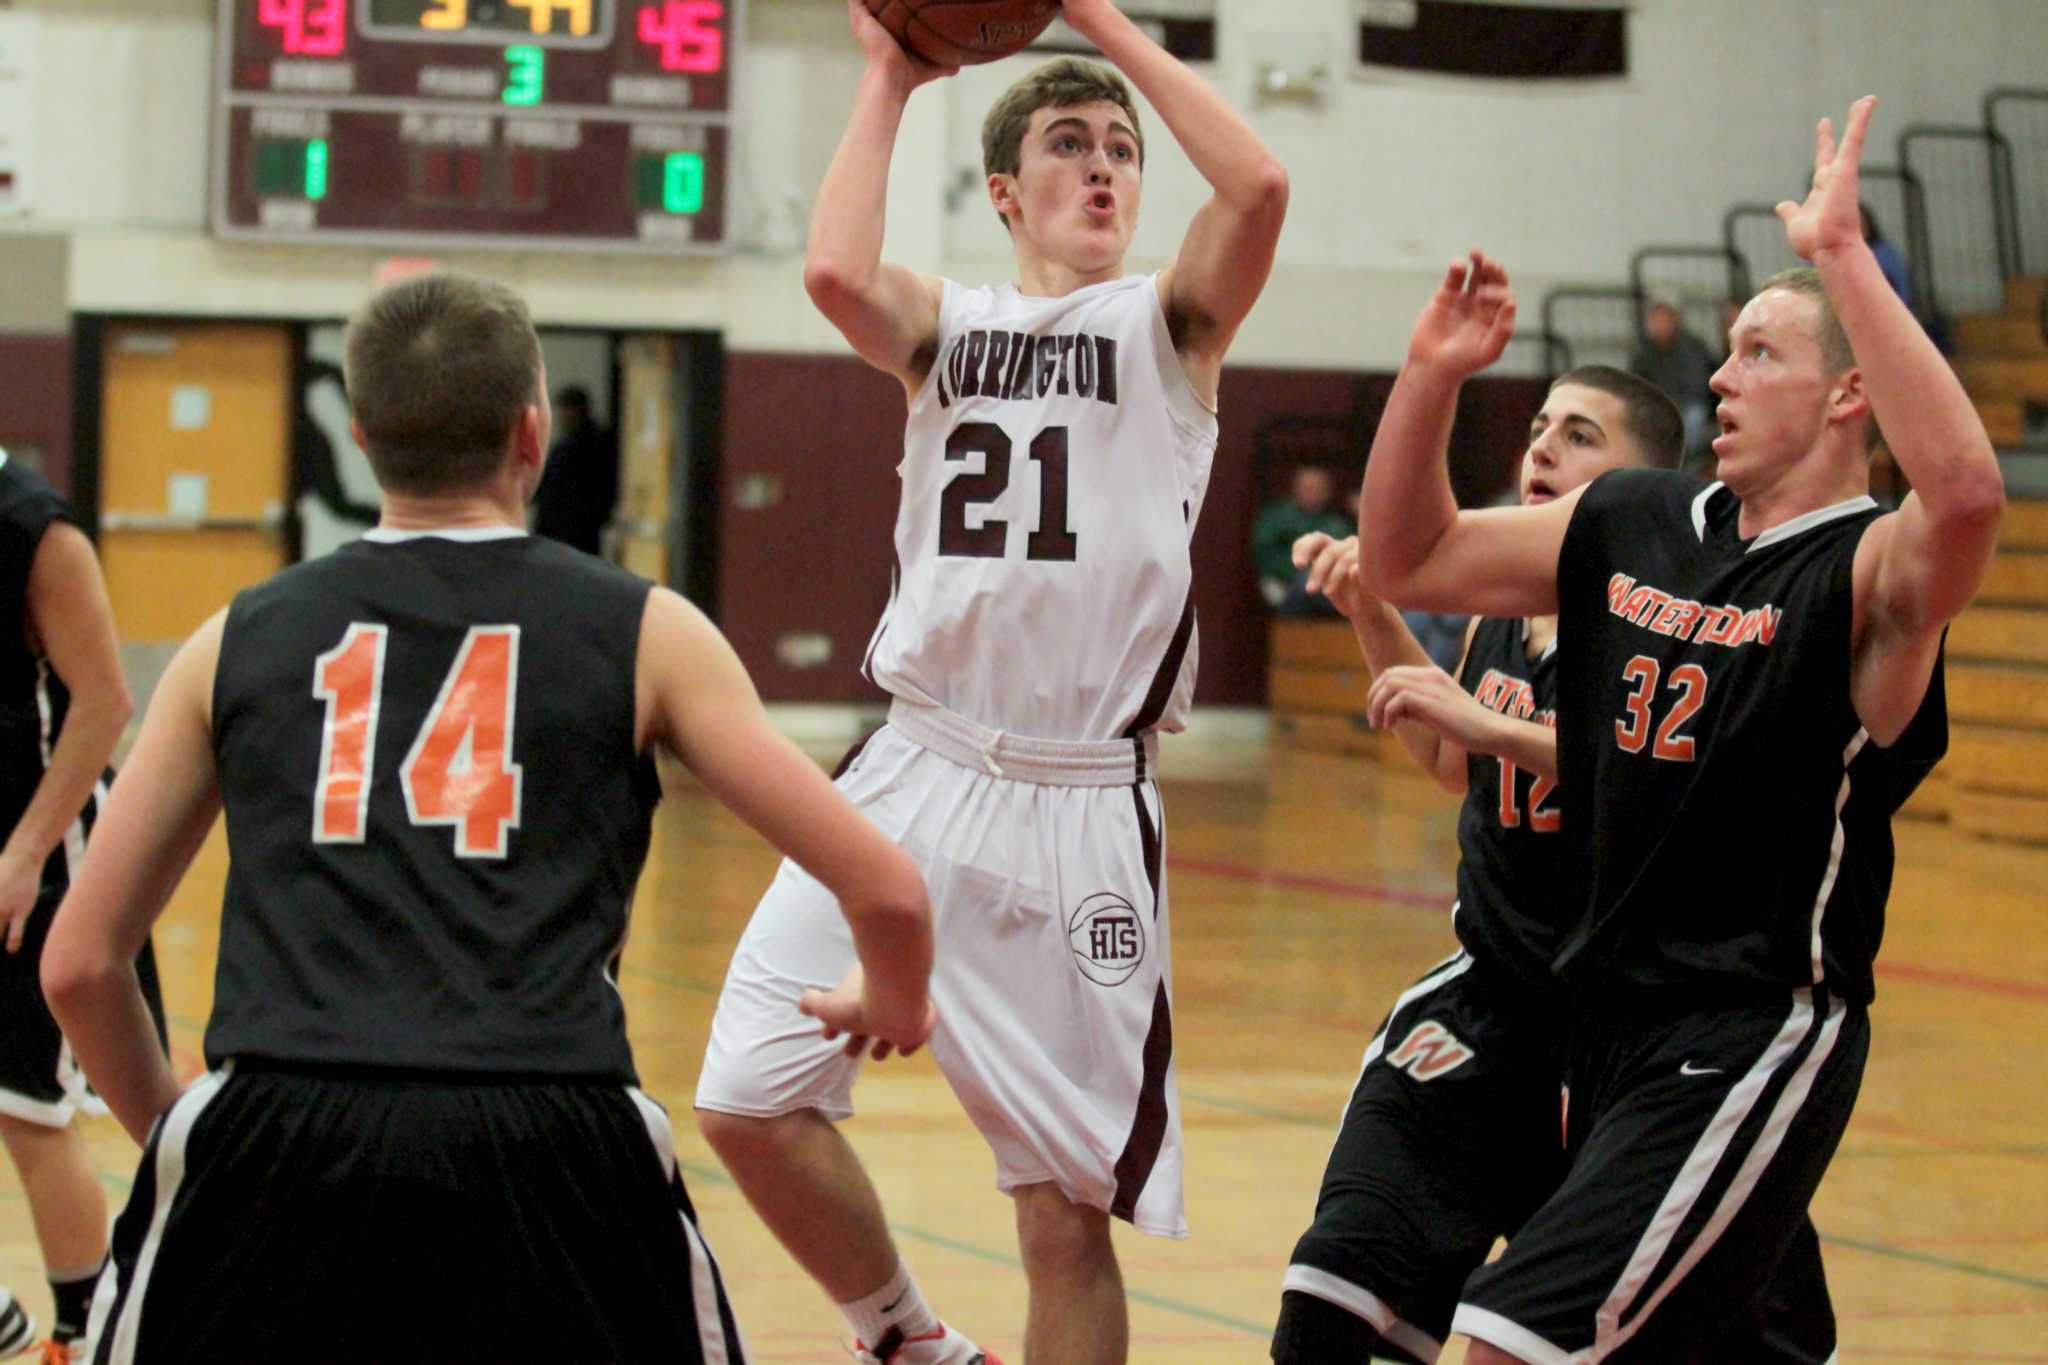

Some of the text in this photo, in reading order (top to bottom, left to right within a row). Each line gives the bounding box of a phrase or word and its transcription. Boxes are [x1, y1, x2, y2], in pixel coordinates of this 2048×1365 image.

[259, 0, 345, 55] 43
[637, 0, 722, 72] 45
[502, 44, 545, 106] 3
[306, 139, 328, 200] 1
[663, 152, 704, 213] 0
[938, 422, 1077, 562] 21
[312, 621, 523, 860] 14
[1615, 655, 1708, 762] 32
